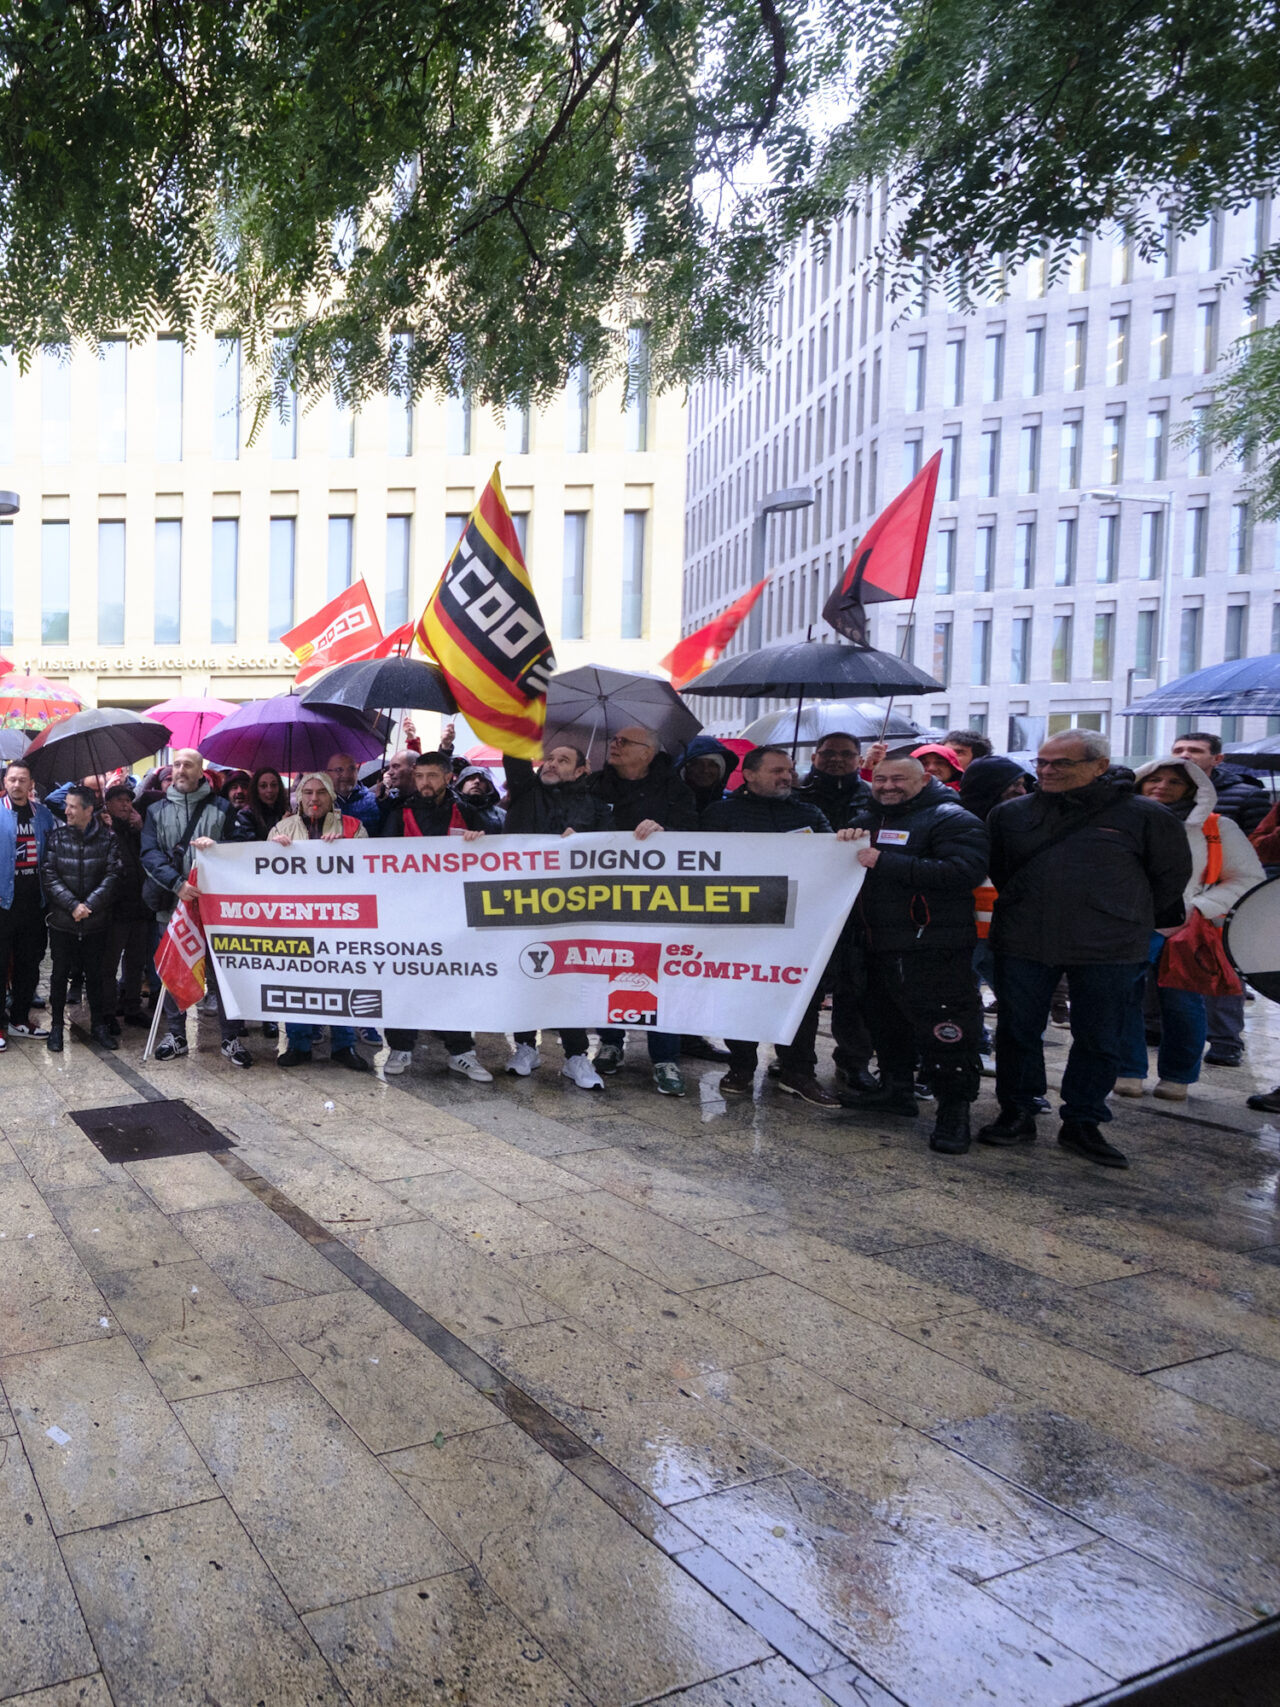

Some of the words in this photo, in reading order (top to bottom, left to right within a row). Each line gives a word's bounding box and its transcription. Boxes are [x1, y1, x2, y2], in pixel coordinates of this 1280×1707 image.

[114, 655, 135, 669] de
[255, 856, 307, 875] POR
[316, 855, 355, 874] UN
[362, 850, 561, 874] TRANSPORTE
[569, 849, 666, 871] DIGNO
[677, 850, 721, 872] EN
[219, 901, 361, 921] MOVENTIS
[481, 884, 760, 916] L'HOSPITALET
[213, 937, 312, 955] MALTRATA
[316, 942, 331, 955] A
[335, 940, 443, 956] PERSONAS
[216, 955, 367, 975] TRABAJADORAS
[373, 961, 386, 975] Y
[392, 961, 499, 977] USUARIAS
[527, 950, 549, 973] Y
[564, 946, 635, 967] AMB
[663, 951, 809, 985] CÓMPLIC
[266, 989, 343, 1011] CCOO
[608, 1008, 657, 1024] CGT
